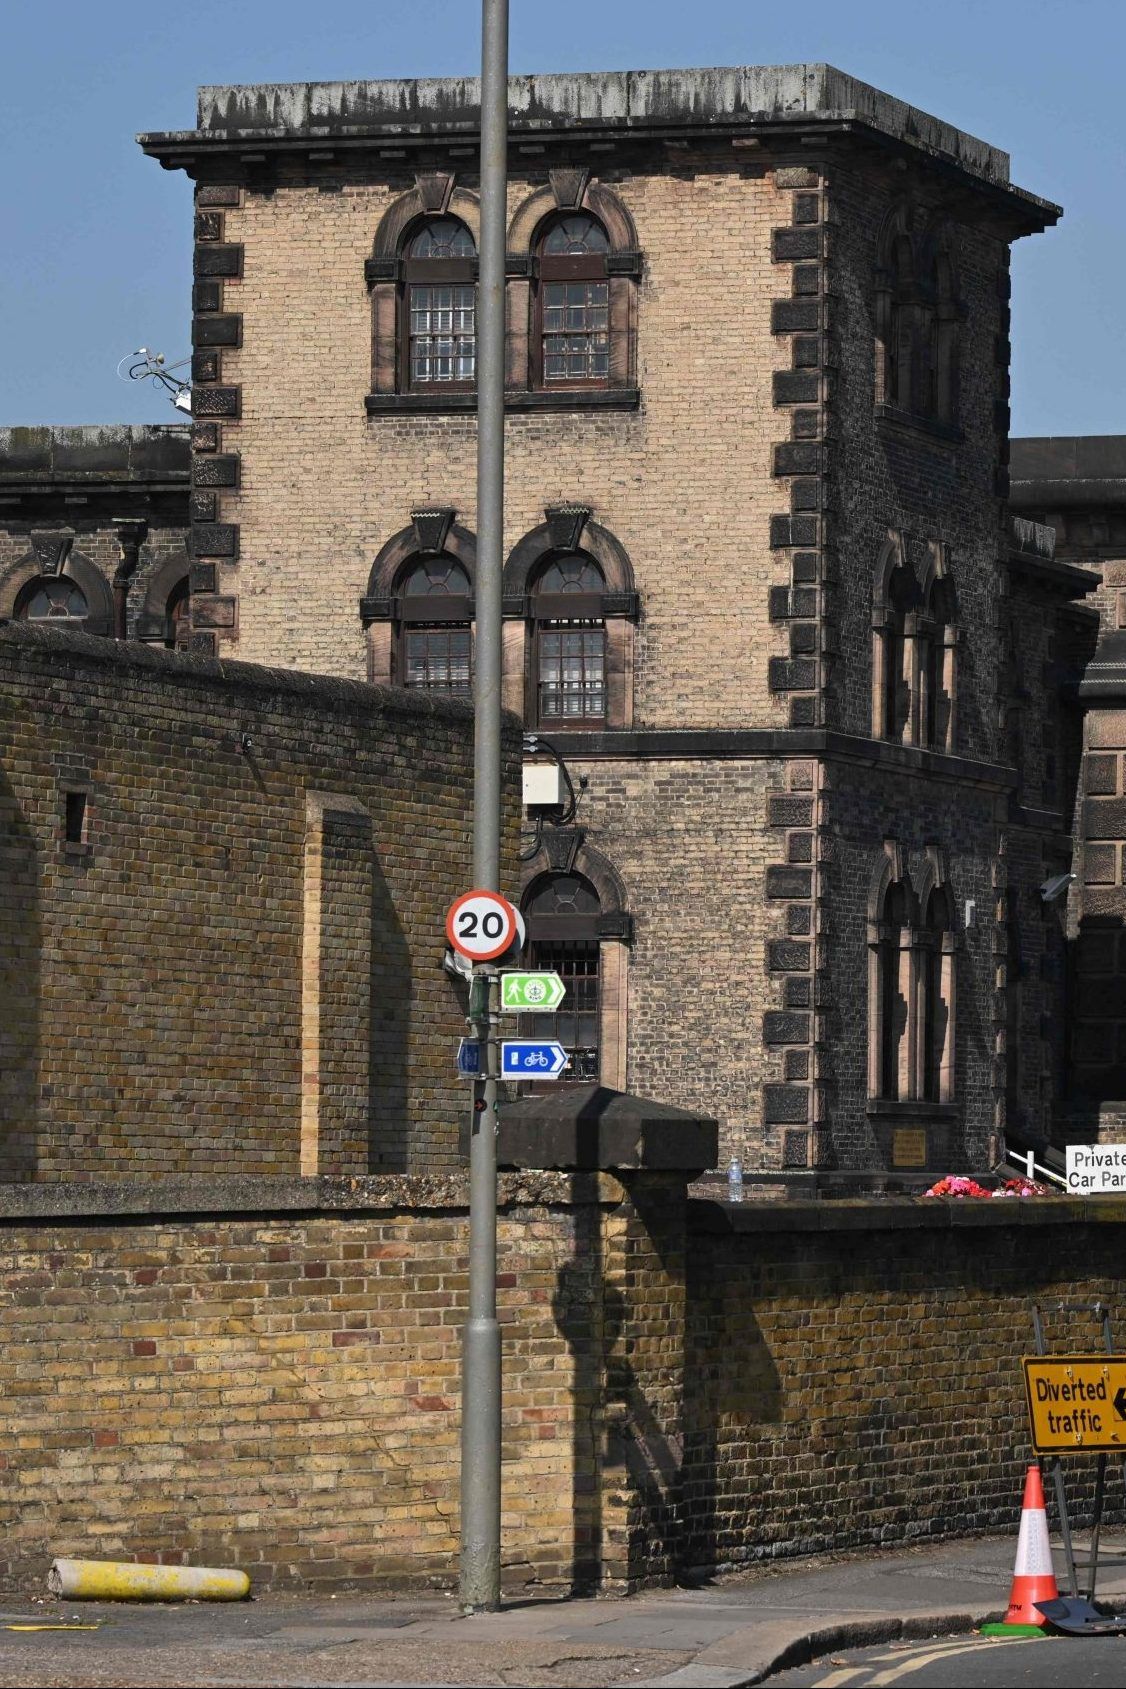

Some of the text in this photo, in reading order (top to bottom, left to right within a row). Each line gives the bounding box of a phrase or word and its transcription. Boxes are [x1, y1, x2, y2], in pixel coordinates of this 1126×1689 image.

[458, 911, 504, 939] 20
[1068, 1172, 1096, 1188] Car
[1035, 1377, 1107, 1402] Diverted
[1047, 1409, 1102, 1434] traffic
